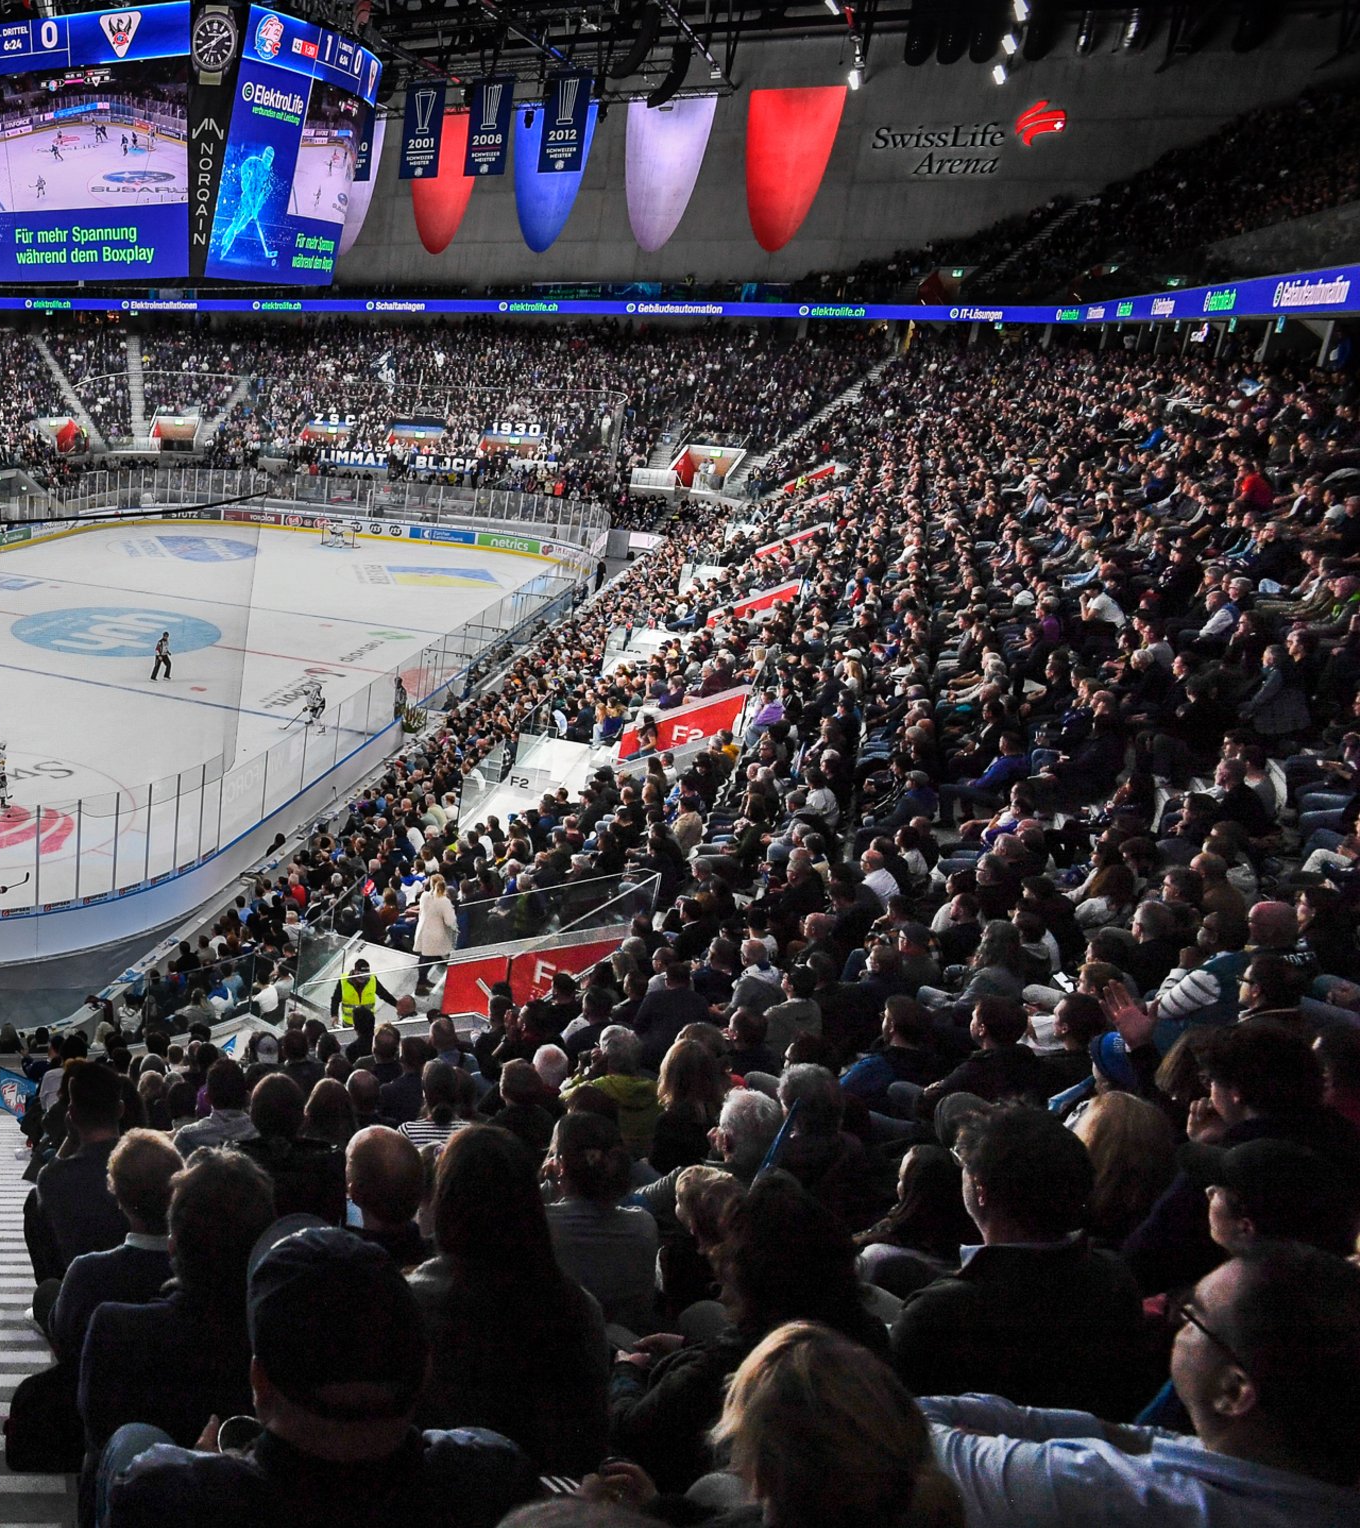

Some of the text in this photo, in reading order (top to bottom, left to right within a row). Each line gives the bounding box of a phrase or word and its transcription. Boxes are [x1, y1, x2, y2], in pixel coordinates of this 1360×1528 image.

[3, 26, 29, 37] DRITTEL
[41, 20, 59, 49] 0
[3, 38, 23, 51] 6:24
[324, 35, 333, 61] 1
[254, 84, 304, 115] ElektroLife
[472, 134, 503, 146] 2008
[548, 129, 578, 141] 2012
[407, 137, 435, 149] 2001
[911, 151, 1000, 176] Arena
[192, 142, 214, 246] NORQAIN
[15, 226, 138, 245] Für mehr Spannung
[16, 246, 155, 265] während dem Boxplay
[32, 299, 71, 309] elektrolife.ch
[130, 300, 198, 310] Elektroinstallationen
[261, 302, 302, 311] elektrolife.ch
[375, 301, 426, 312] Schaltanlagen
[509, 302, 559, 313] elektrolife.ch
[637, 302, 723, 315] Gebäudeautomation
[811, 305, 866, 317] elektrolife.ch
[959, 308, 1003, 321] IT-Lösungen
[492, 422, 542, 437] 1930
[320, 449, 388, 467] LIMMAT
[415, 454, 478, 472] BLOCK
[490, 537, 529, 552] netrics
[510, 775, 529, 789] F2
